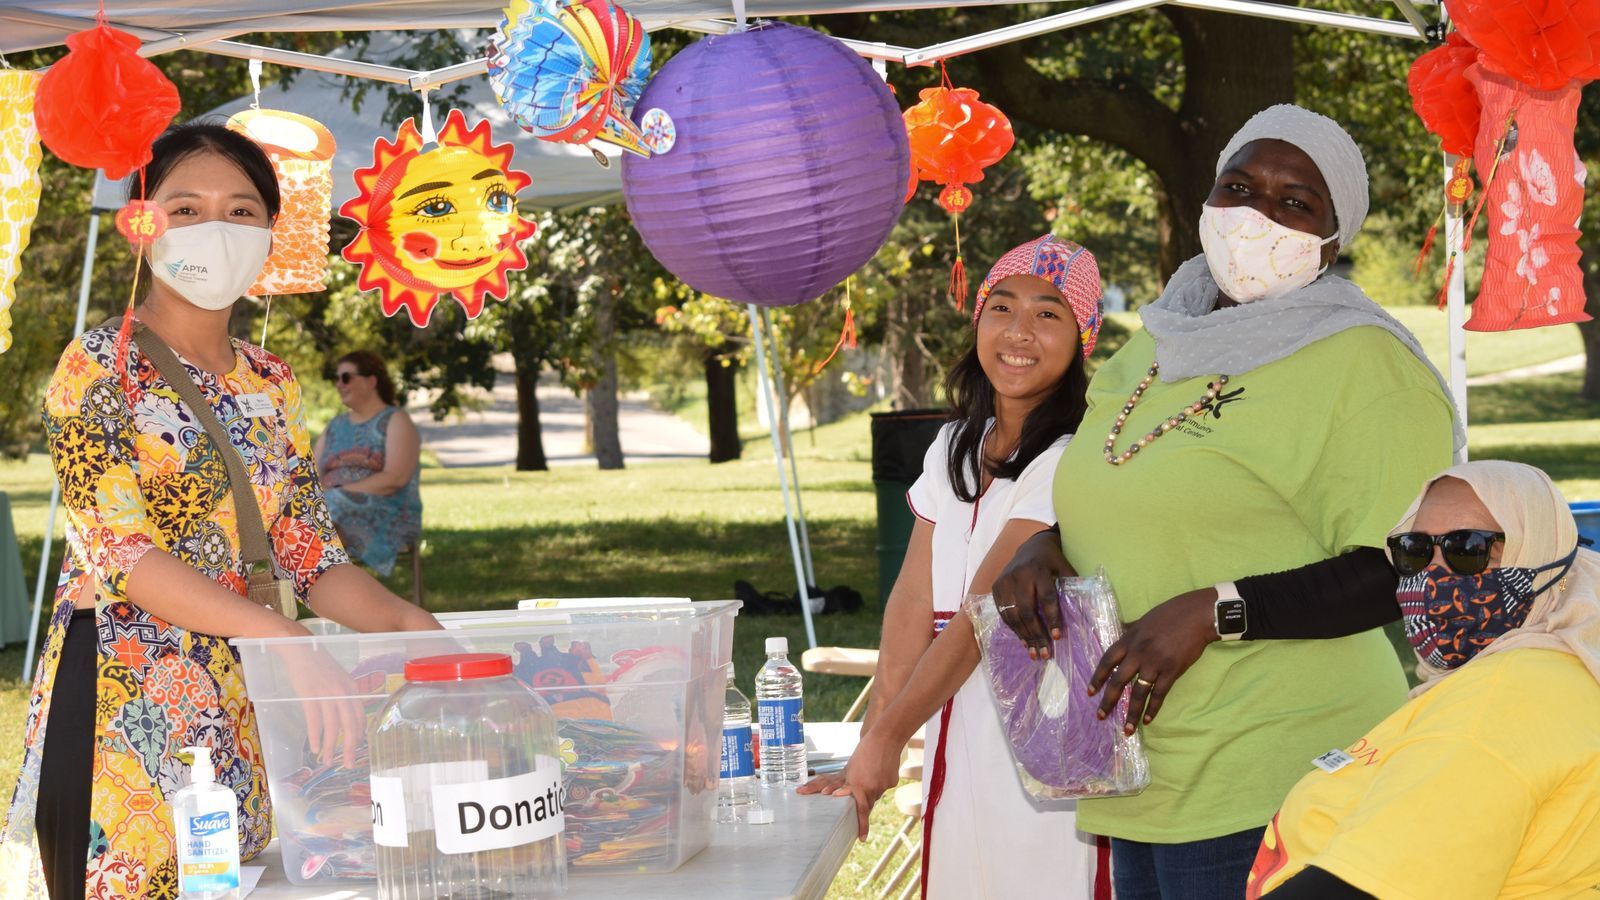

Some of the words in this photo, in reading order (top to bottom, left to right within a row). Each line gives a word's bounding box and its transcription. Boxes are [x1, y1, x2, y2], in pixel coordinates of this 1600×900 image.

[128, 209, 156, 236] 福
[182, 264, 208, 273] APTA
[1184, 417, 1213, 433] mmunity
[191, 817, 229, 831] Suave
[187, 840, 211, 848] HAND
